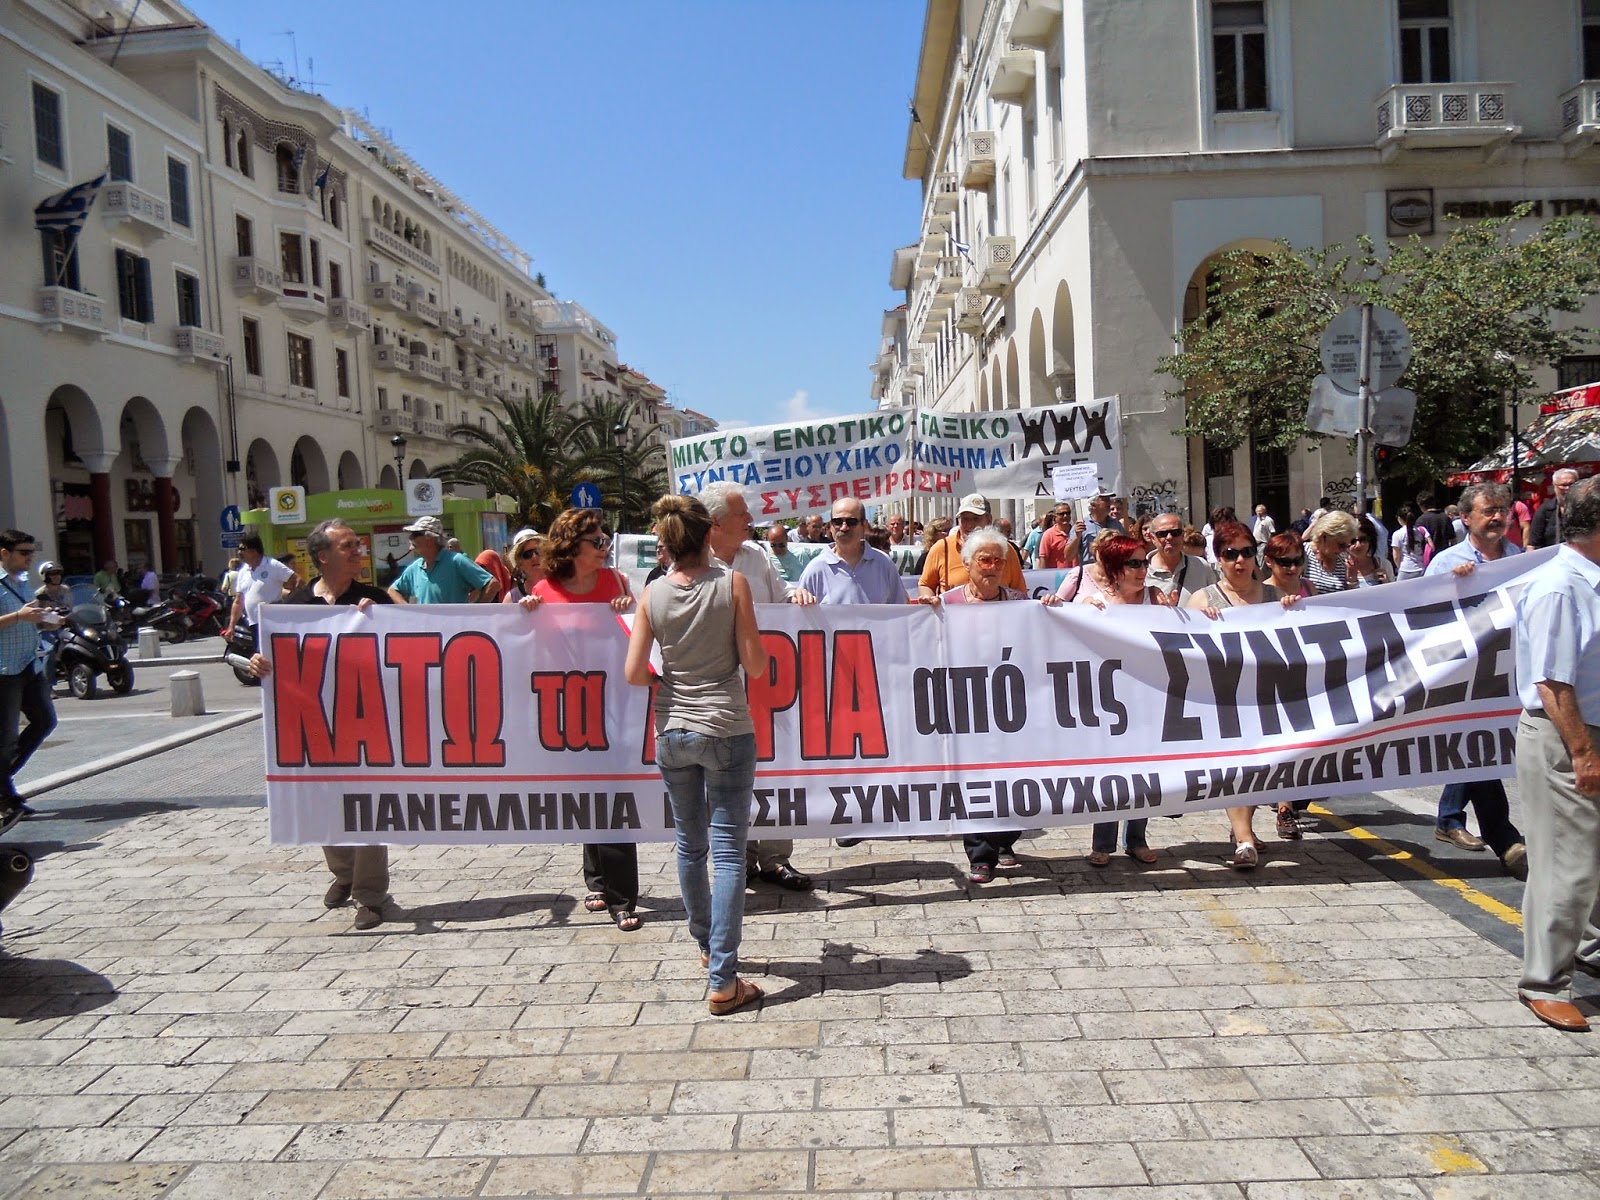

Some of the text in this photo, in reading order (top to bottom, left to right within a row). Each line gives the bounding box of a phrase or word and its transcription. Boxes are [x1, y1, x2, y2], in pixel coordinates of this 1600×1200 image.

[673, 435, 748, 468] ΜΙΚΤΟ
[773, 413, 905, 452] ΕΝΩΤΙΚΟ
[920, 412, 1010, 440] ΤΑΞΙΚΟ
[679, 440, 1007, 495] ΣΥΝΤΑΞΙΟΥΧΙΚΟ ΚΙΝΗΜΑ
[270, 582, 1528, 768] ΚΑΤΩ τα ΡΙΑ από τις ΣΥΝΤΑΞΕ
[343, 791, 642, 833] ΠΑΝΕΛΛΗΝΙΑ
[830, 772, 1162, 827] ΣΥΝΤΑΞΙΟΥΧΩΝ
